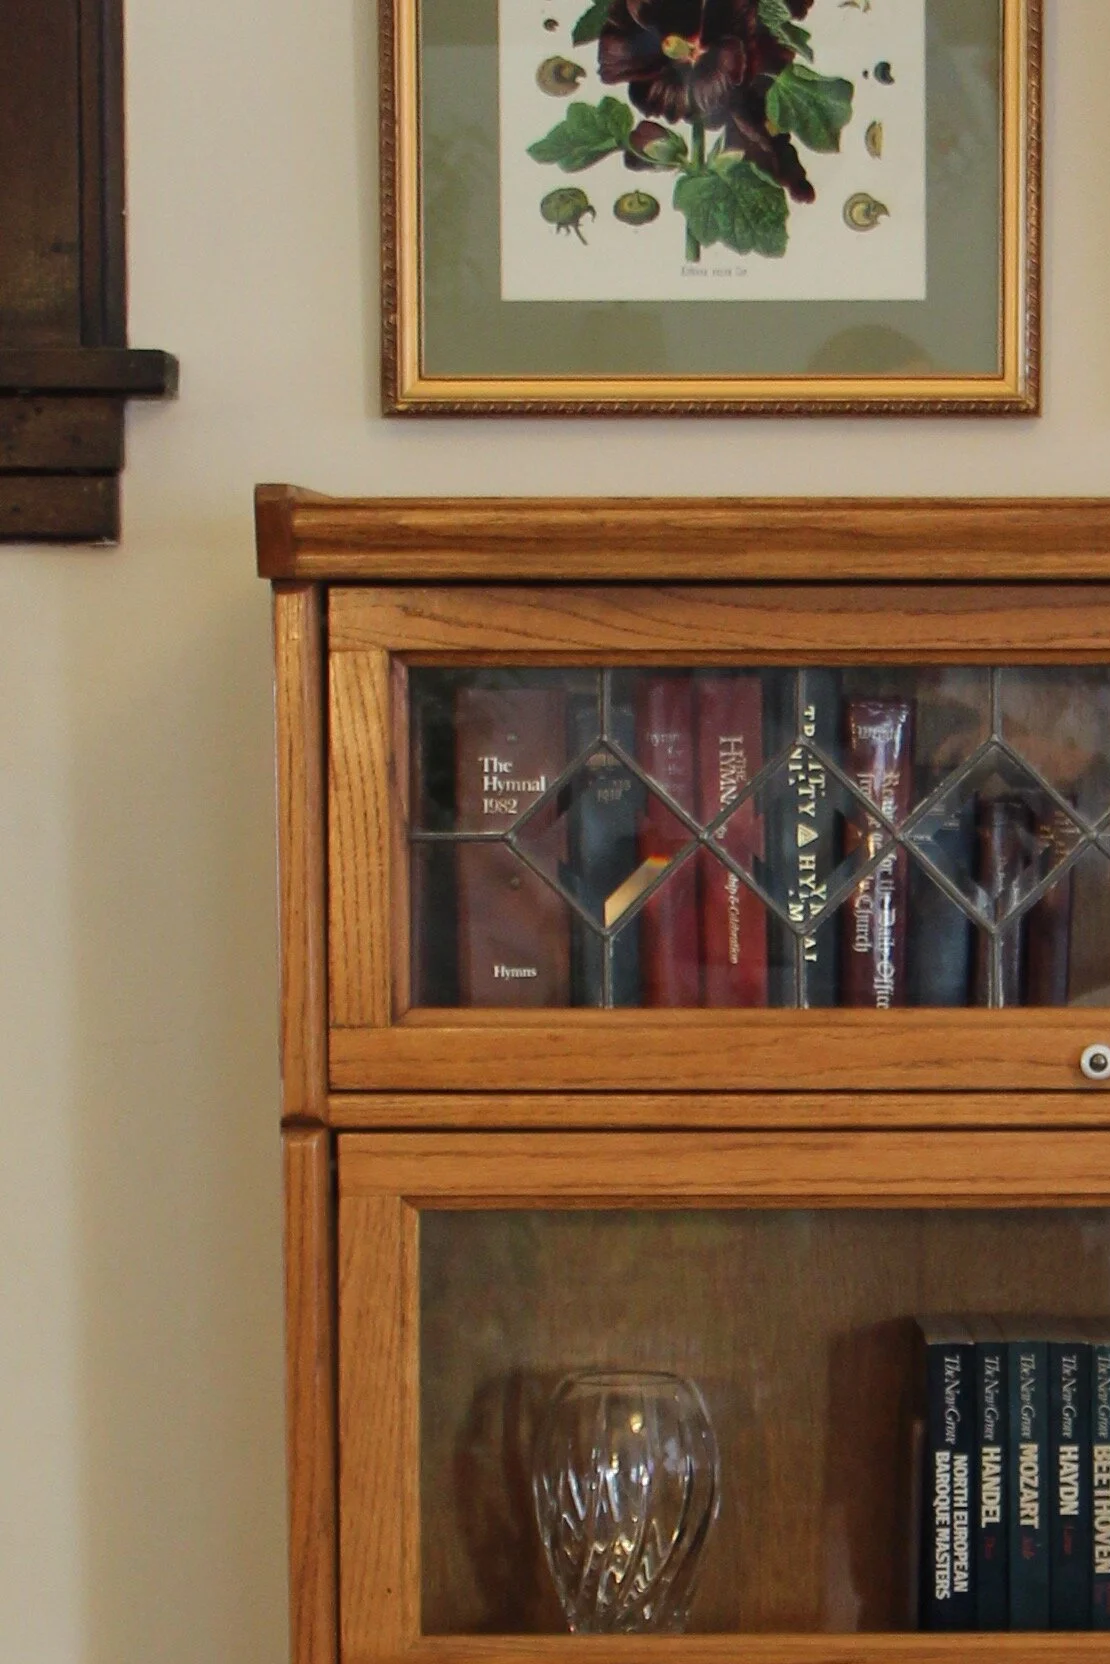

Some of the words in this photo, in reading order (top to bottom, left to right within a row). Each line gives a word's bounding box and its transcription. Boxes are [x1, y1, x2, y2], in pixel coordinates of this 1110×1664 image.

[479, 756, 512, 773] The
[483, 776, 546, 794] Hymnal
[483, 798, 517, 814] 1982
[728, 907, 740, 965] Celebration
[852, 895, 872, 952] Church
[877, 907, 896, 956] Daily
[494, 965, 537, 979] Hymns
[944, 1355, 960, 1379] The
[983, 1356, 999, 1378] The
[1020, 1354, 1034, 1377] The
[1062, 1355, 1077, 1376] The
[1097, 1355, 1110, 1378] The
[932, 1451, 950, 1524] BAROQUE
[953, 1455, 968, 1507] NORTH
[982, 1447, 1000, 1528] HANDEL
[1019, 1443, 1038, 1529] MOZART
[1059, 1445, 1079, 1515] HAYDN
[935, 1528, 951, 1599] MASTERS
[954, 1511, 968, 1592] EUROPEAN
